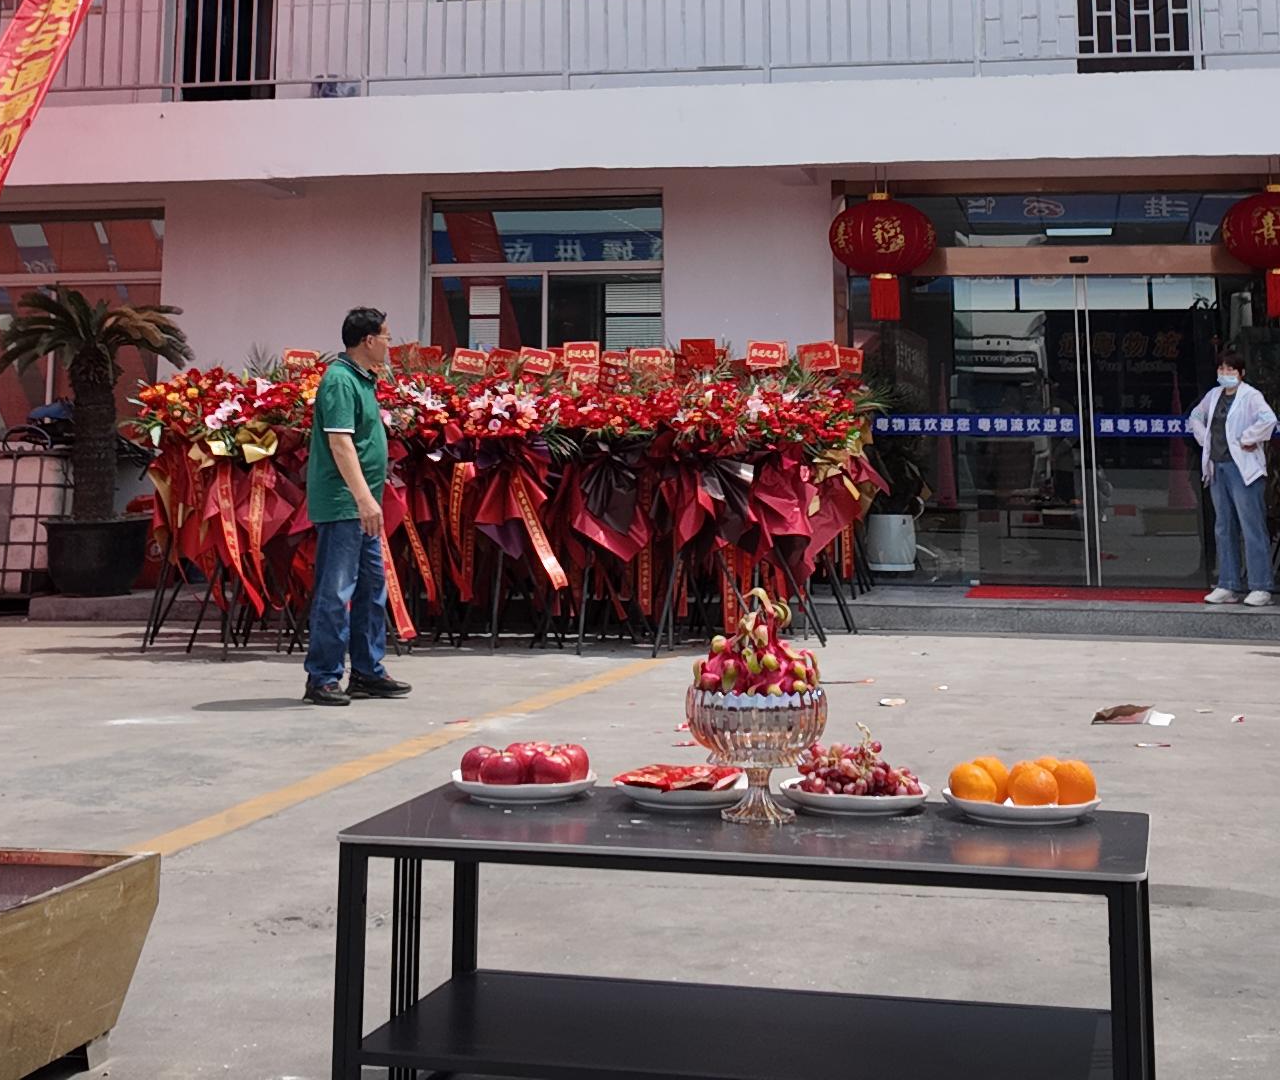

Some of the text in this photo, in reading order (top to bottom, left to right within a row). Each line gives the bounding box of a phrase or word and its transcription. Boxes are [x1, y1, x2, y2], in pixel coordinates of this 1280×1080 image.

[871, 418, 970, 432] 粤物流欢迎您
